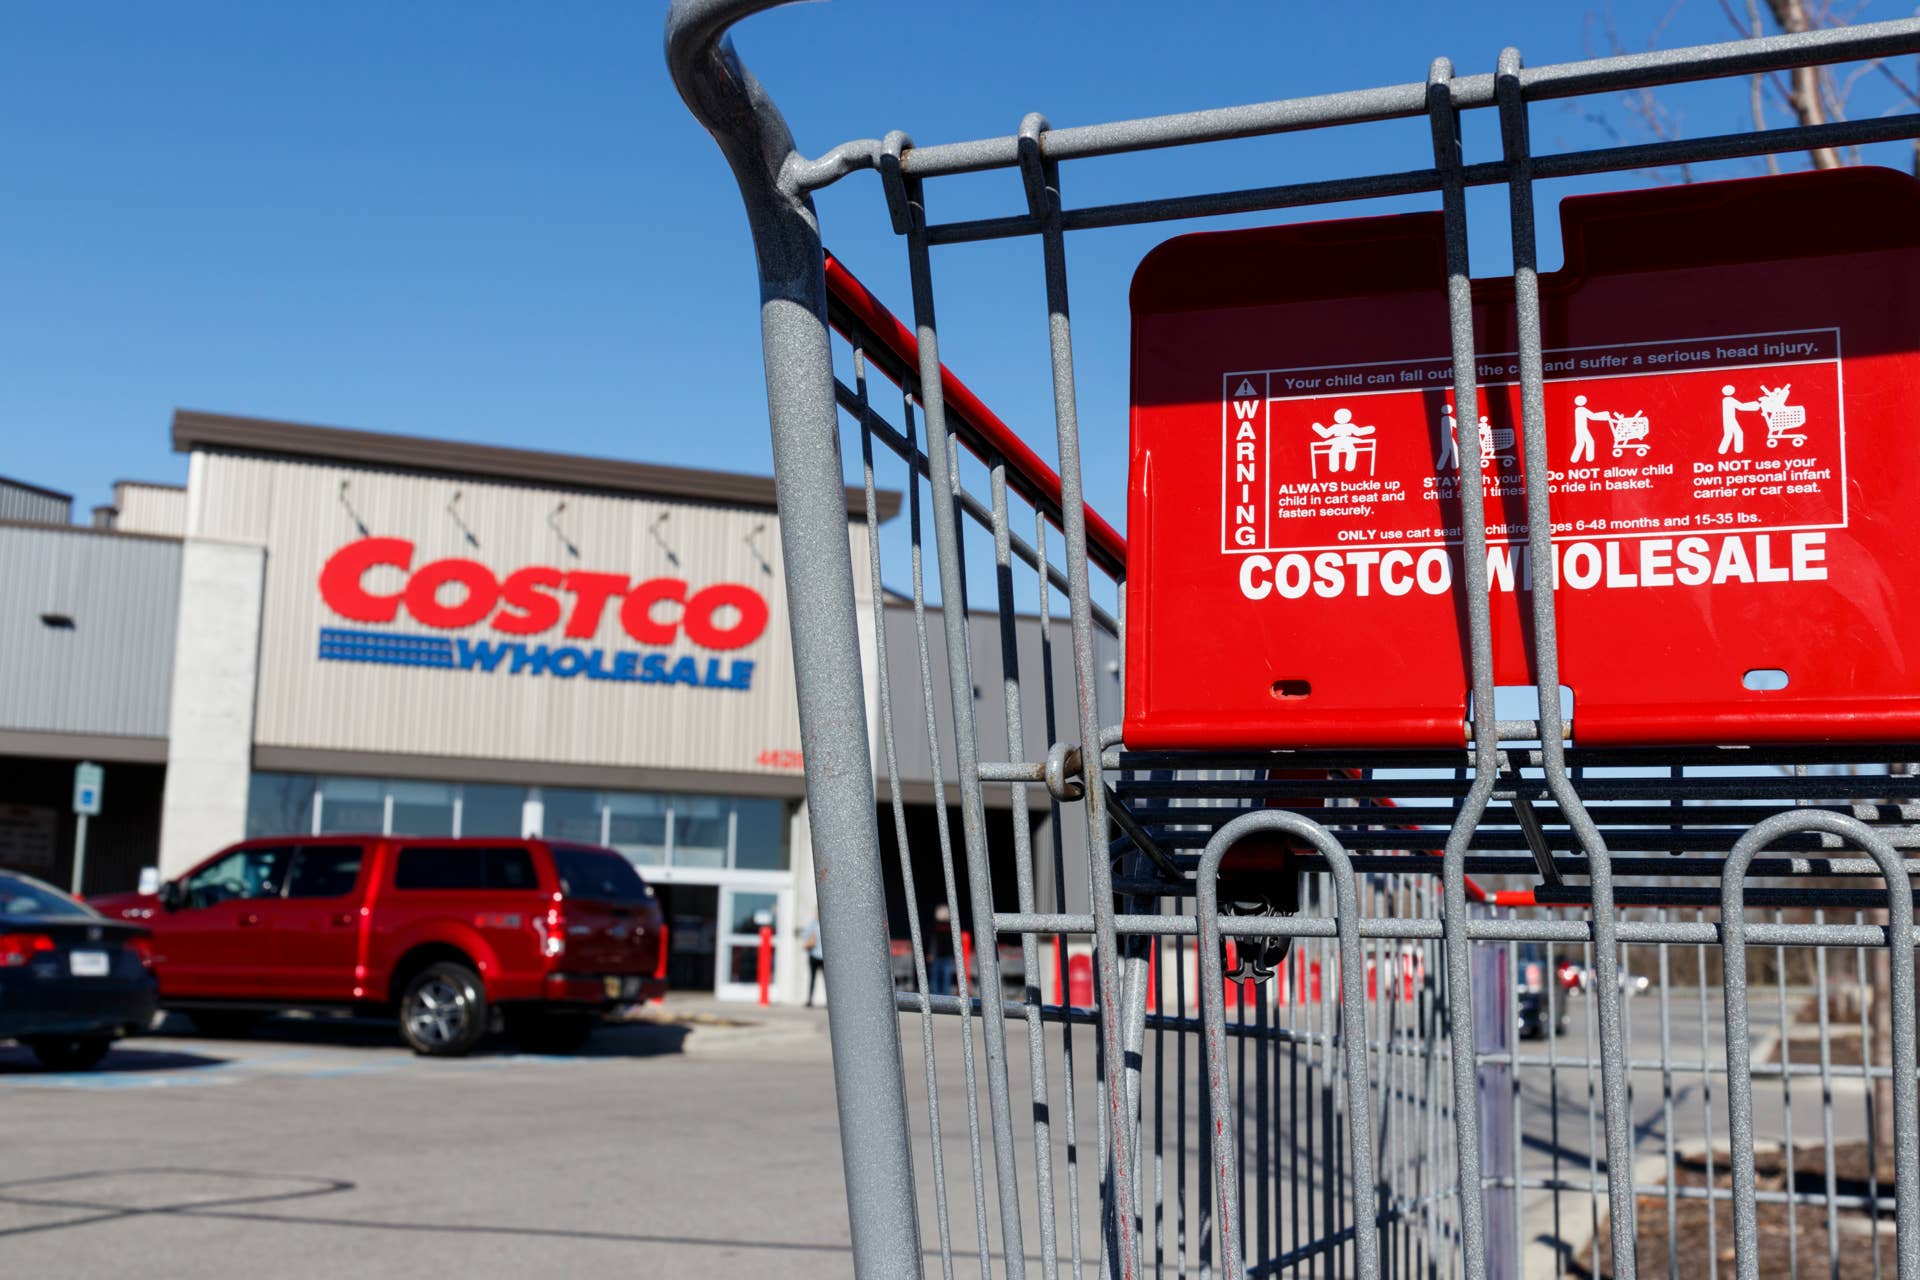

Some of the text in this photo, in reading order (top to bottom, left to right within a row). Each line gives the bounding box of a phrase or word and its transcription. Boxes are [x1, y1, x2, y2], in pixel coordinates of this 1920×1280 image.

[1285, 378, 1320, 390] Your
[1325, 374, 1363, 387] child
[1367, 372, 1395, 384] can
[1400, 369, 1423, 381] fall
[1427, 367, 1453, 380] out
[1478, 364, 1503, 377] the
[1544, 359, 1575, 372] and
[1580, 356, 1628, 369] suffer
[1633, 355, 1643, 366] a
[1647, 349, 1711, 364] serious
[1716, 345, 1758, 359] head
[1764, 341, 1818, 357] injury.
[1232, 400, 1260, 546] WARNING
[1568, 467, 1600, 480] NOT
[1603, 466, 1638, 478] allow
[1641, 463, 1673, 476] child
[1693, 457, 1817, 473] Do NOT use your
[1423, 476, 1461, 488] STAY
[1494, 474, 1524, 486] your
[1693, 467, 1831, 486] own personal infant
[1278, 480, 1400, 495] ALWAYS buckle up
[1423, 488, 1453, 500] child
[1490, 485, 1525, 497] times
[1561, 481, 1586, 493] ride
[1589, 481, 1602, 491] in
[1605, 478, 1654, 491] basket.
[1693, 482, 1821, 499] carrier or car seat.
[1278, 490, 1405, 507] child in cart seat and
[1278, 504, 1375, 519] fasten securely.
[1337, 530, 1377, 541] ONLY
[1380, 530, 1403, 539] use
[1406, 526, 1431, 538] cart
[1485, 523, 1529, 535] childre
[1550, 522, 1573, 535] ges
[1576, 519, 1606, 531] 6-48
[1610, 517, 1660, 530] months
[1663, 515, 1690, 527] and
[1694, 514, 1734, 525] 15-35
[1737, 512, 1762, 524] lbs.
[1239, 548, 1453, 600] COSTCO
[318, 536, 770, 651] COSTCO
[453, 638, 756, 691] WHOLESALE
